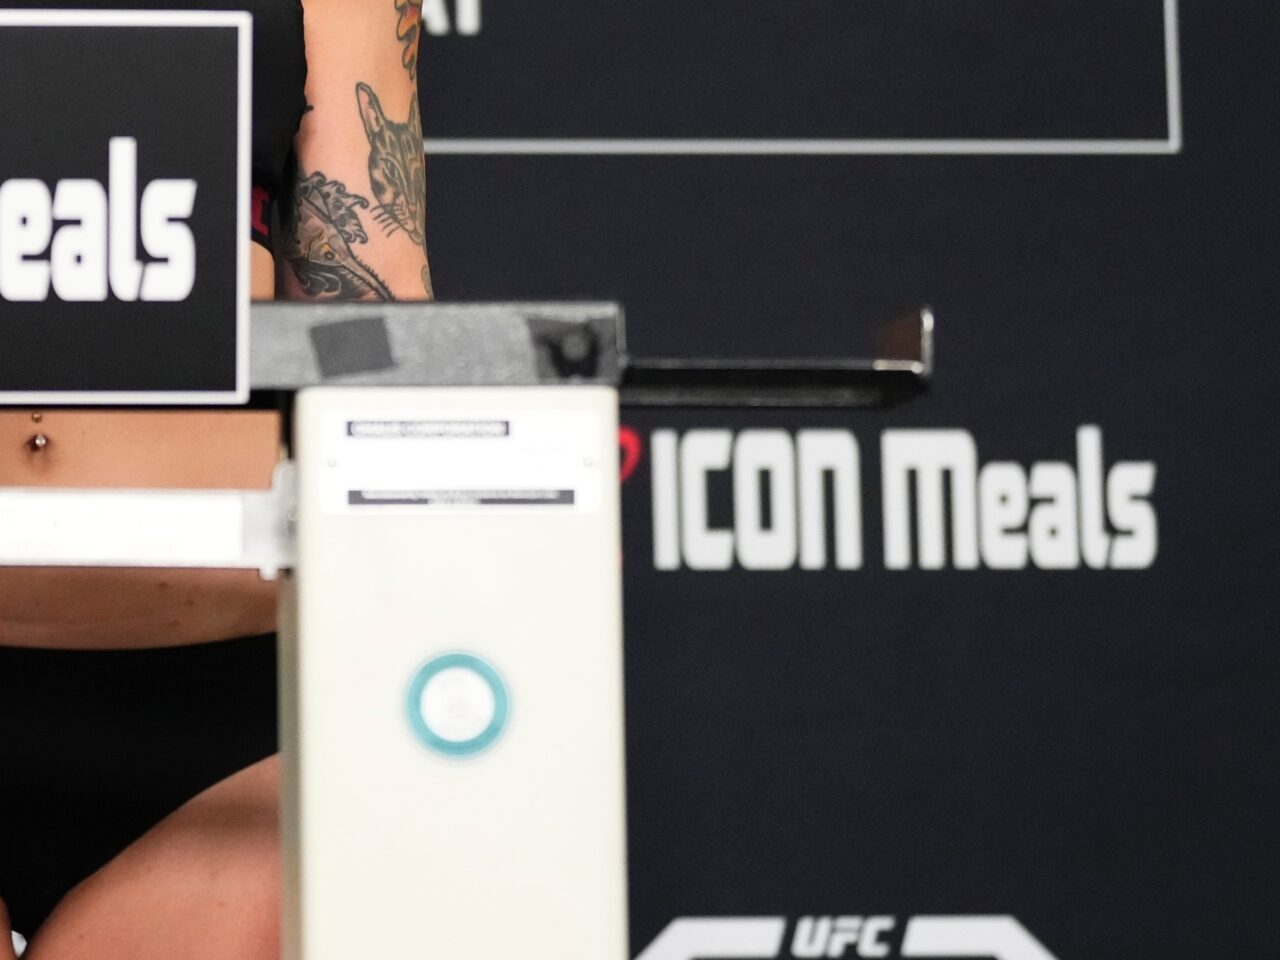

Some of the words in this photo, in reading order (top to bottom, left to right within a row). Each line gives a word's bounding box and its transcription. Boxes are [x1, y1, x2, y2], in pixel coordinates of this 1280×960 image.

[650, 427, 863, 571] ICON
[880, 425, 1158, 570] Meals
[790, 916, 895, 958] UFC
